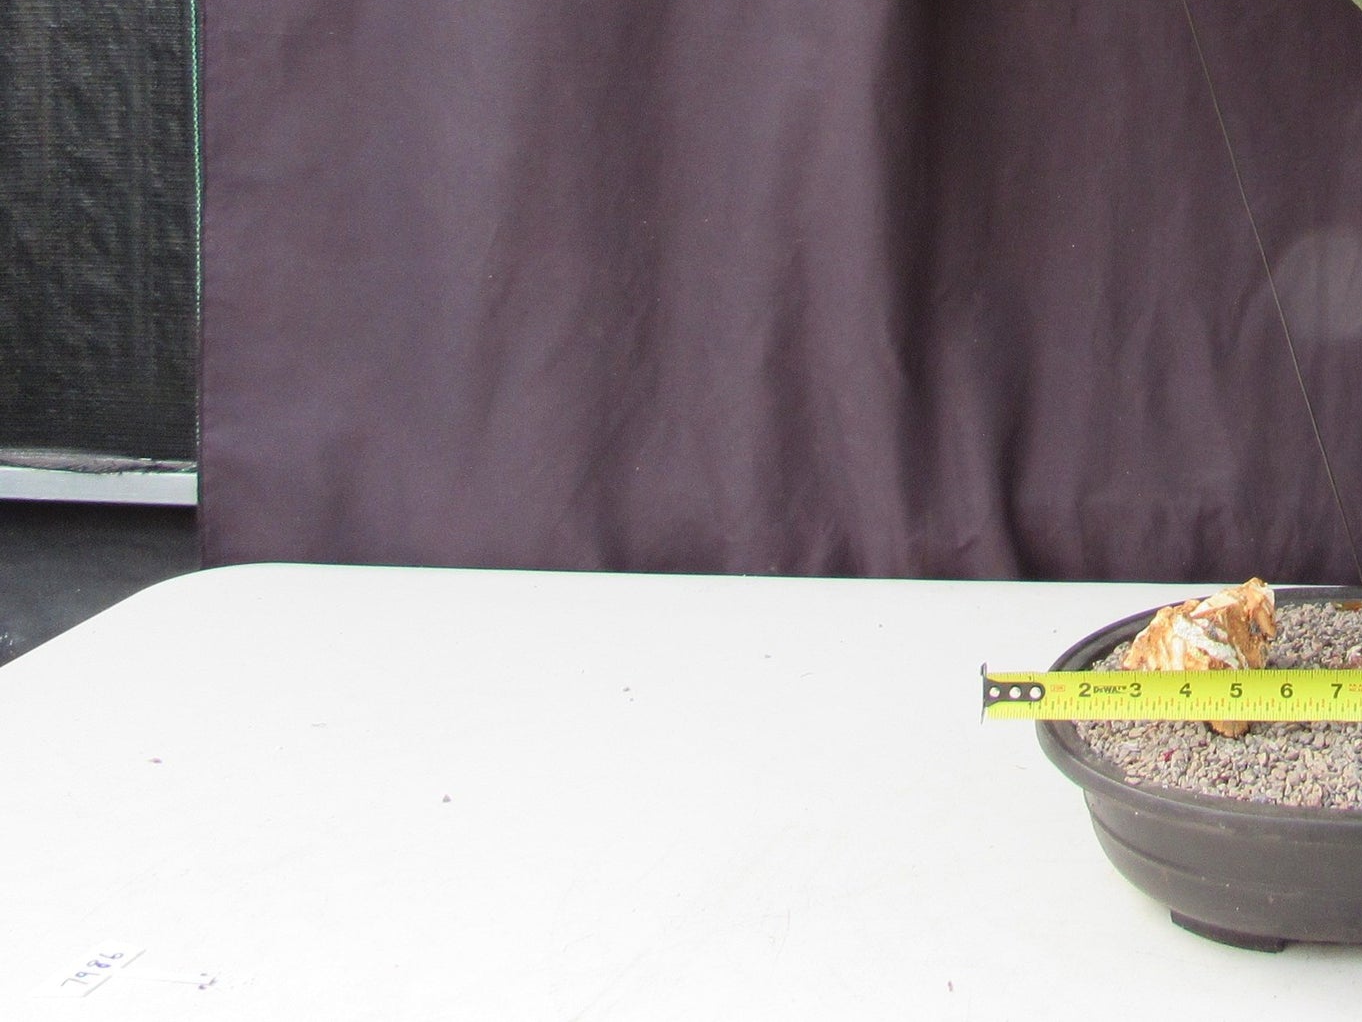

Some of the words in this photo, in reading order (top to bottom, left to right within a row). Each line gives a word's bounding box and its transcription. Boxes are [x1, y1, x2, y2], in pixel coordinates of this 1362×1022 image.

[1078, 682, 1091, 698] 2
[1129, 682, 1142, 698] 3
[1179, 682, 1192, 698] 4
[1230, 682, 1243, 699] 5
[1280, 682, 1293, 699] 6
[1330, 683, 1343, 699] 7
